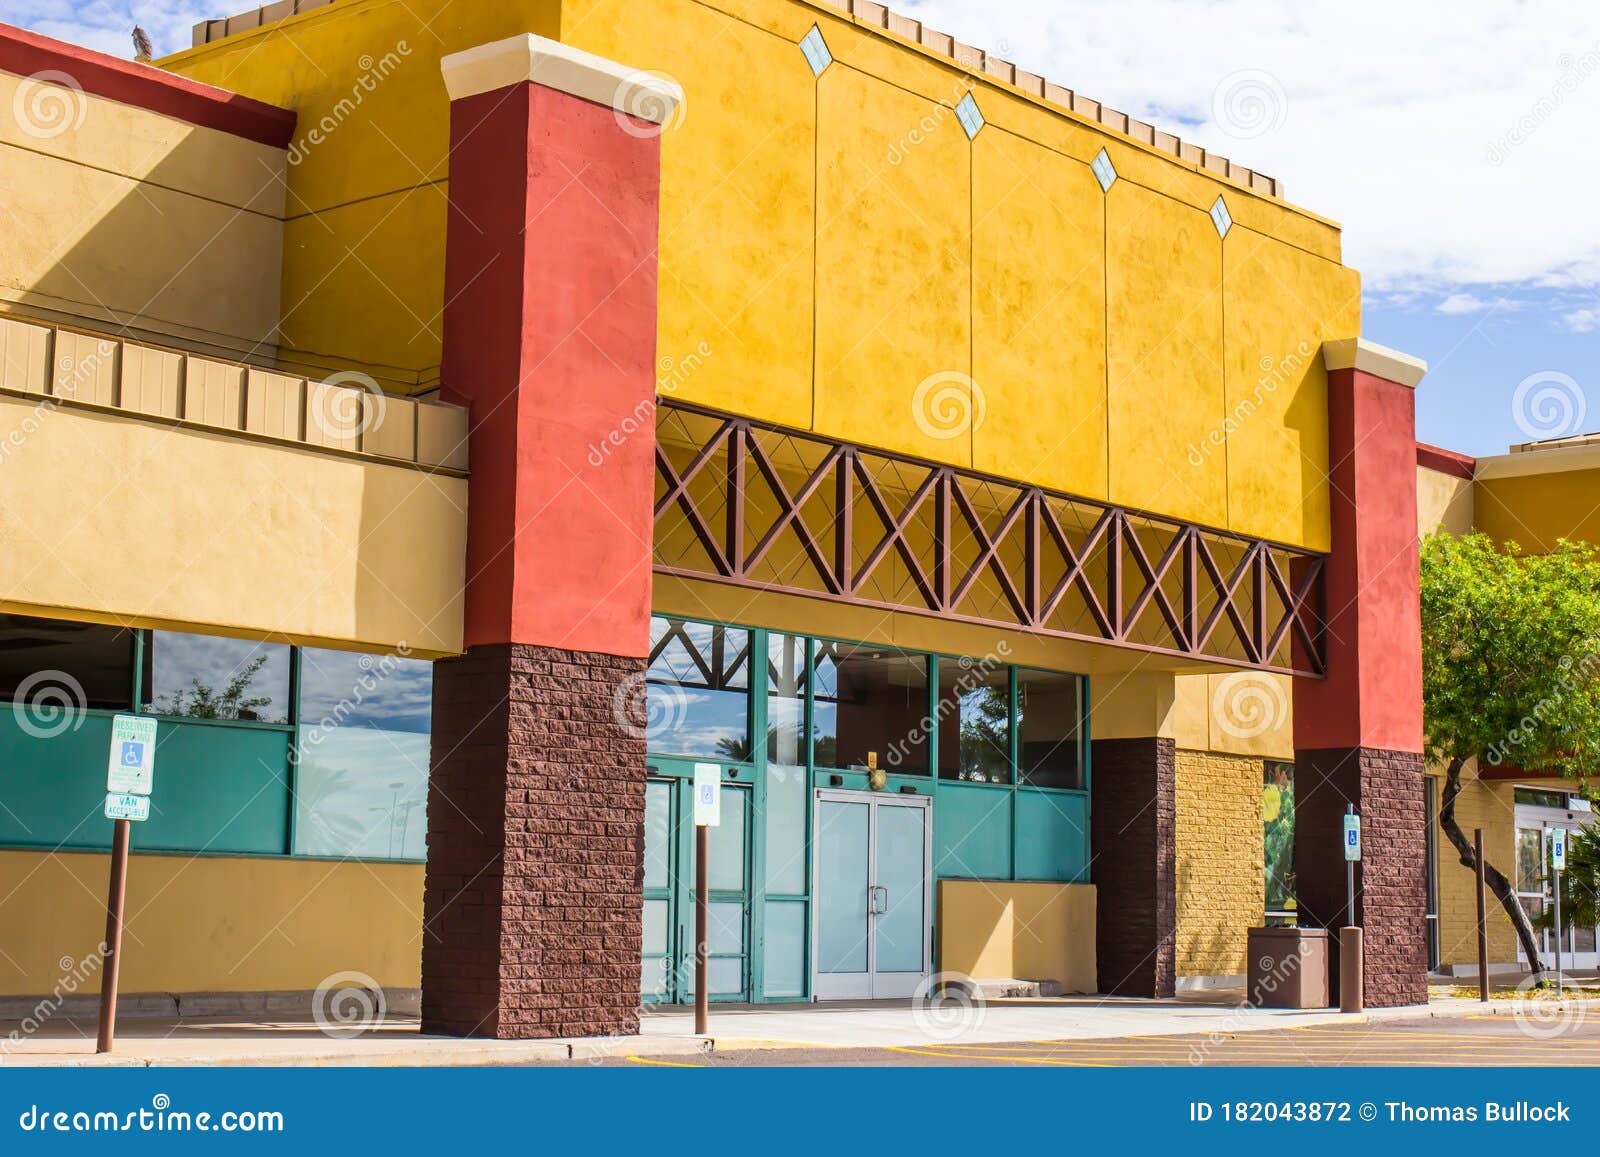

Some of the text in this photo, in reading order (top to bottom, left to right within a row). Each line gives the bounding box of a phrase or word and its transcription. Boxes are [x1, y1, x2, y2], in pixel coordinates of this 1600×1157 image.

[115, 719, 155, 733] RESERVED
[119, 797, 137, 806] VAN
[108, 806, 145, 817] ACCESSIBLE
